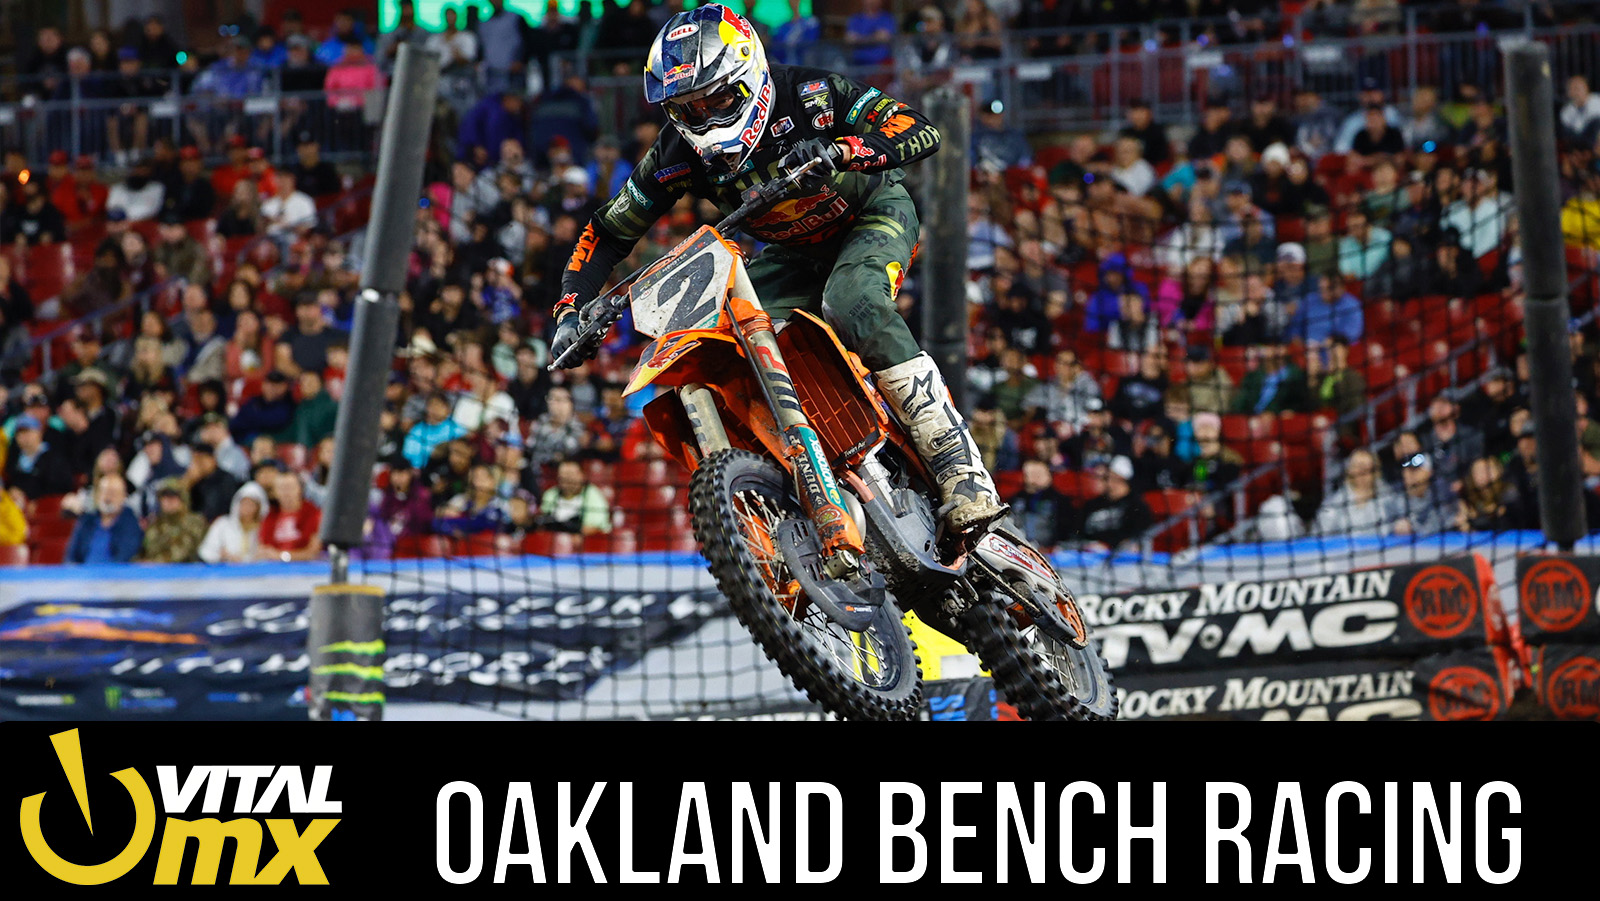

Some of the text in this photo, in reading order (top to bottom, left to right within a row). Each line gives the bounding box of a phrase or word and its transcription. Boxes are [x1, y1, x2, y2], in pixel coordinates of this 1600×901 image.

[670, 27, 694, 38] BELL
[895, 124, 941, 161] THOR
[567, 221, 601, 272] KTM
[657, 252, 716, 337] 2
[789, 434, 821, 495] DUNLP
[809, 438, 837, 490] MOTOREX
[1082, 569, 1395, 626] ROCKY MOUNTAIN
[1218, 671, 1415, 711] MOUNTAIN
